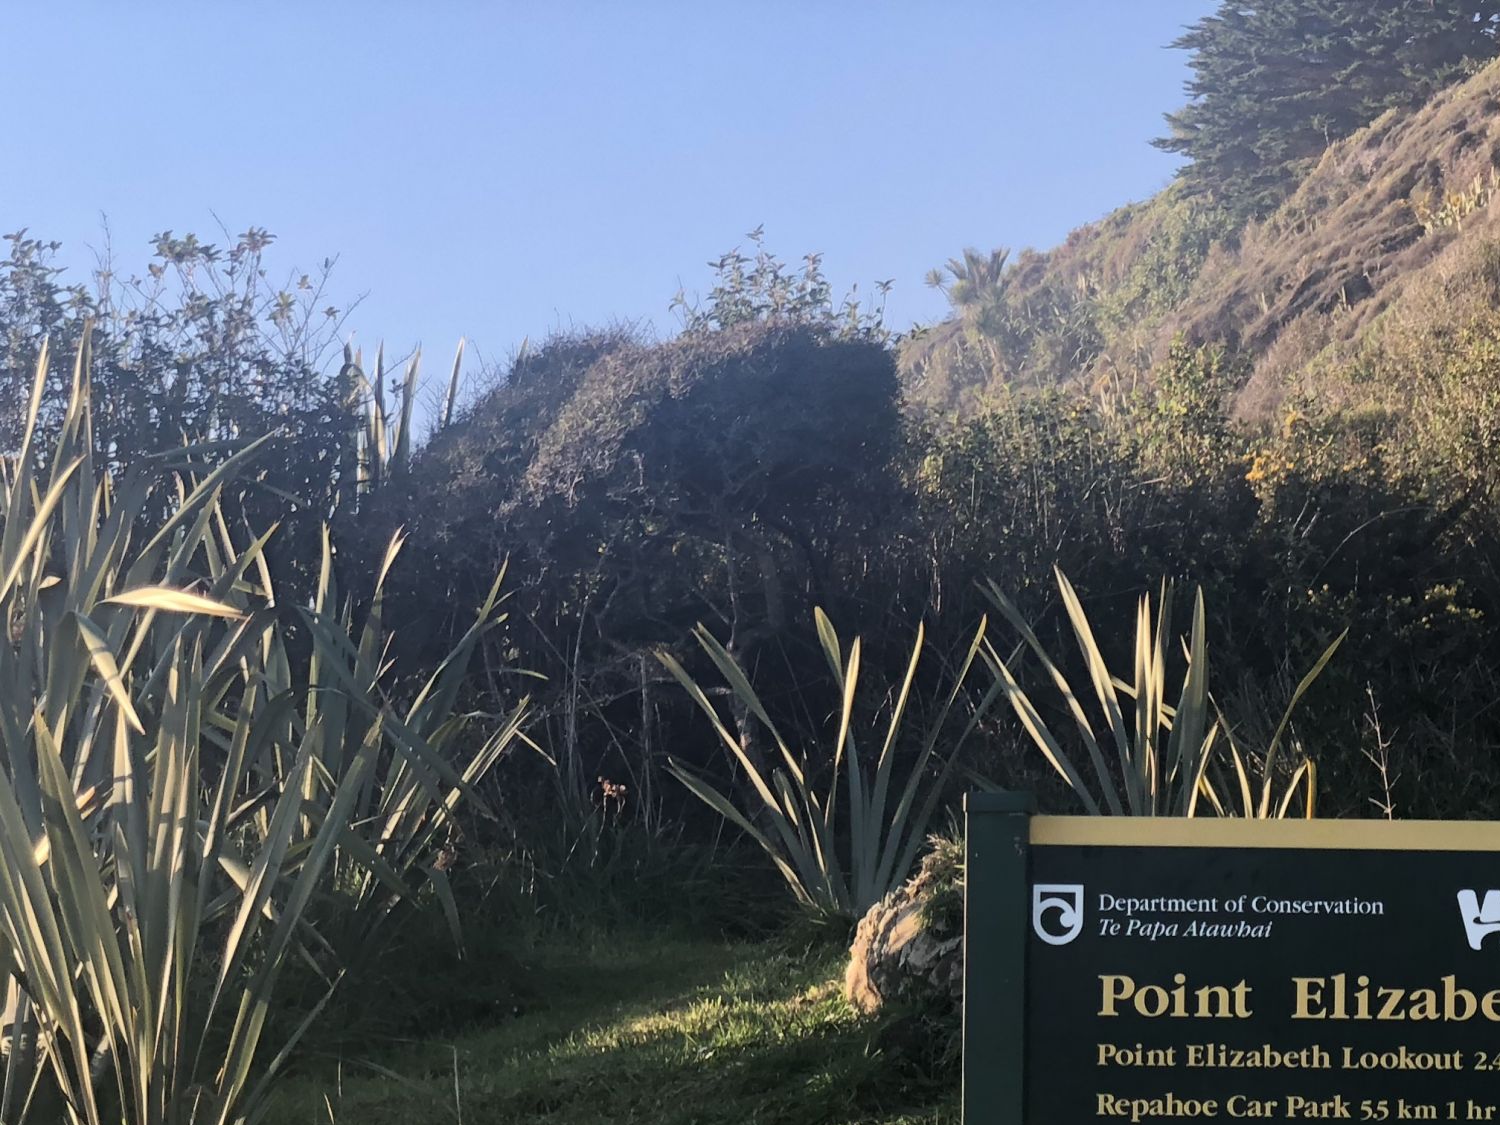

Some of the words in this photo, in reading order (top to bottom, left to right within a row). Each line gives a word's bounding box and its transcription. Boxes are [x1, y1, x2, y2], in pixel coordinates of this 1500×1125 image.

[1098, 893, 1219, 917] Department
[1224, 894, 1248, 913] of
[1251, 895, 1384, 915] Conservation
[1099, 918, 1121, 936] Te
[1125, 918, 1179, 941] Papa
[1182, 919, 1273, 938] Atawhai
[1097, 972, 1253, 1019] Point
[1097, 1043, 1177, 1067] Point
[1186, 1043, 1332, 1069] Elizabeth
[1341, 1045, 1464, 1071] Lookout
[1095, 1092, 1218, 1123] Repahoe
[1226, 1094, 1278, 1118] Car
[1286, 1094, 1352, 1118] Park
[1360, 1099, 1389, 1121] 5.5
[1397, 1098, 1437, 1120] km
[1446, 1101, 1457, 1120] 1
[1466, 1099, 1497, 1120] hr
